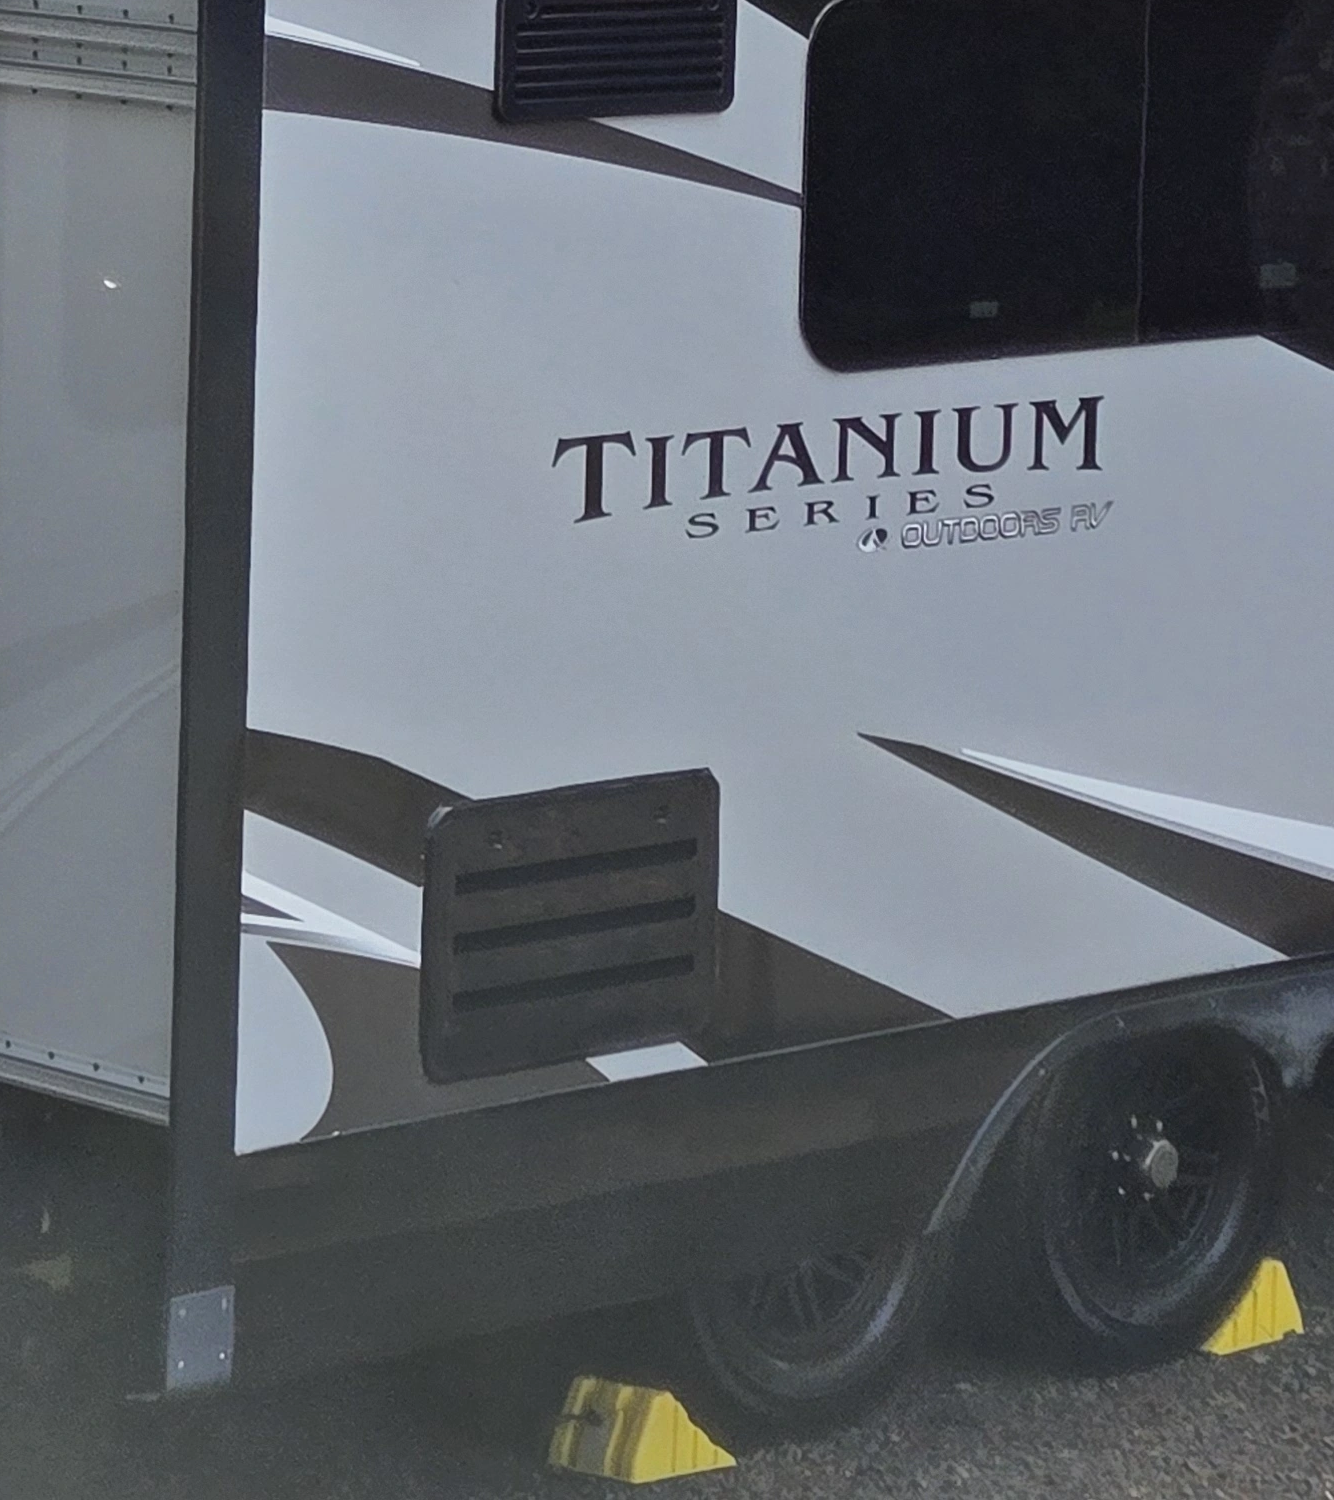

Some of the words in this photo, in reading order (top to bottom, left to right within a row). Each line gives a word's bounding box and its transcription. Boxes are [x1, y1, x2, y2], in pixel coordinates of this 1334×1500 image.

[551, 395, 1105, 524] TITANIUM
[684, 483, 996, 539] SERIES
[901, 507, 1062, 549] OUTDOORS
[1070, 500, 1115, 532] RV
